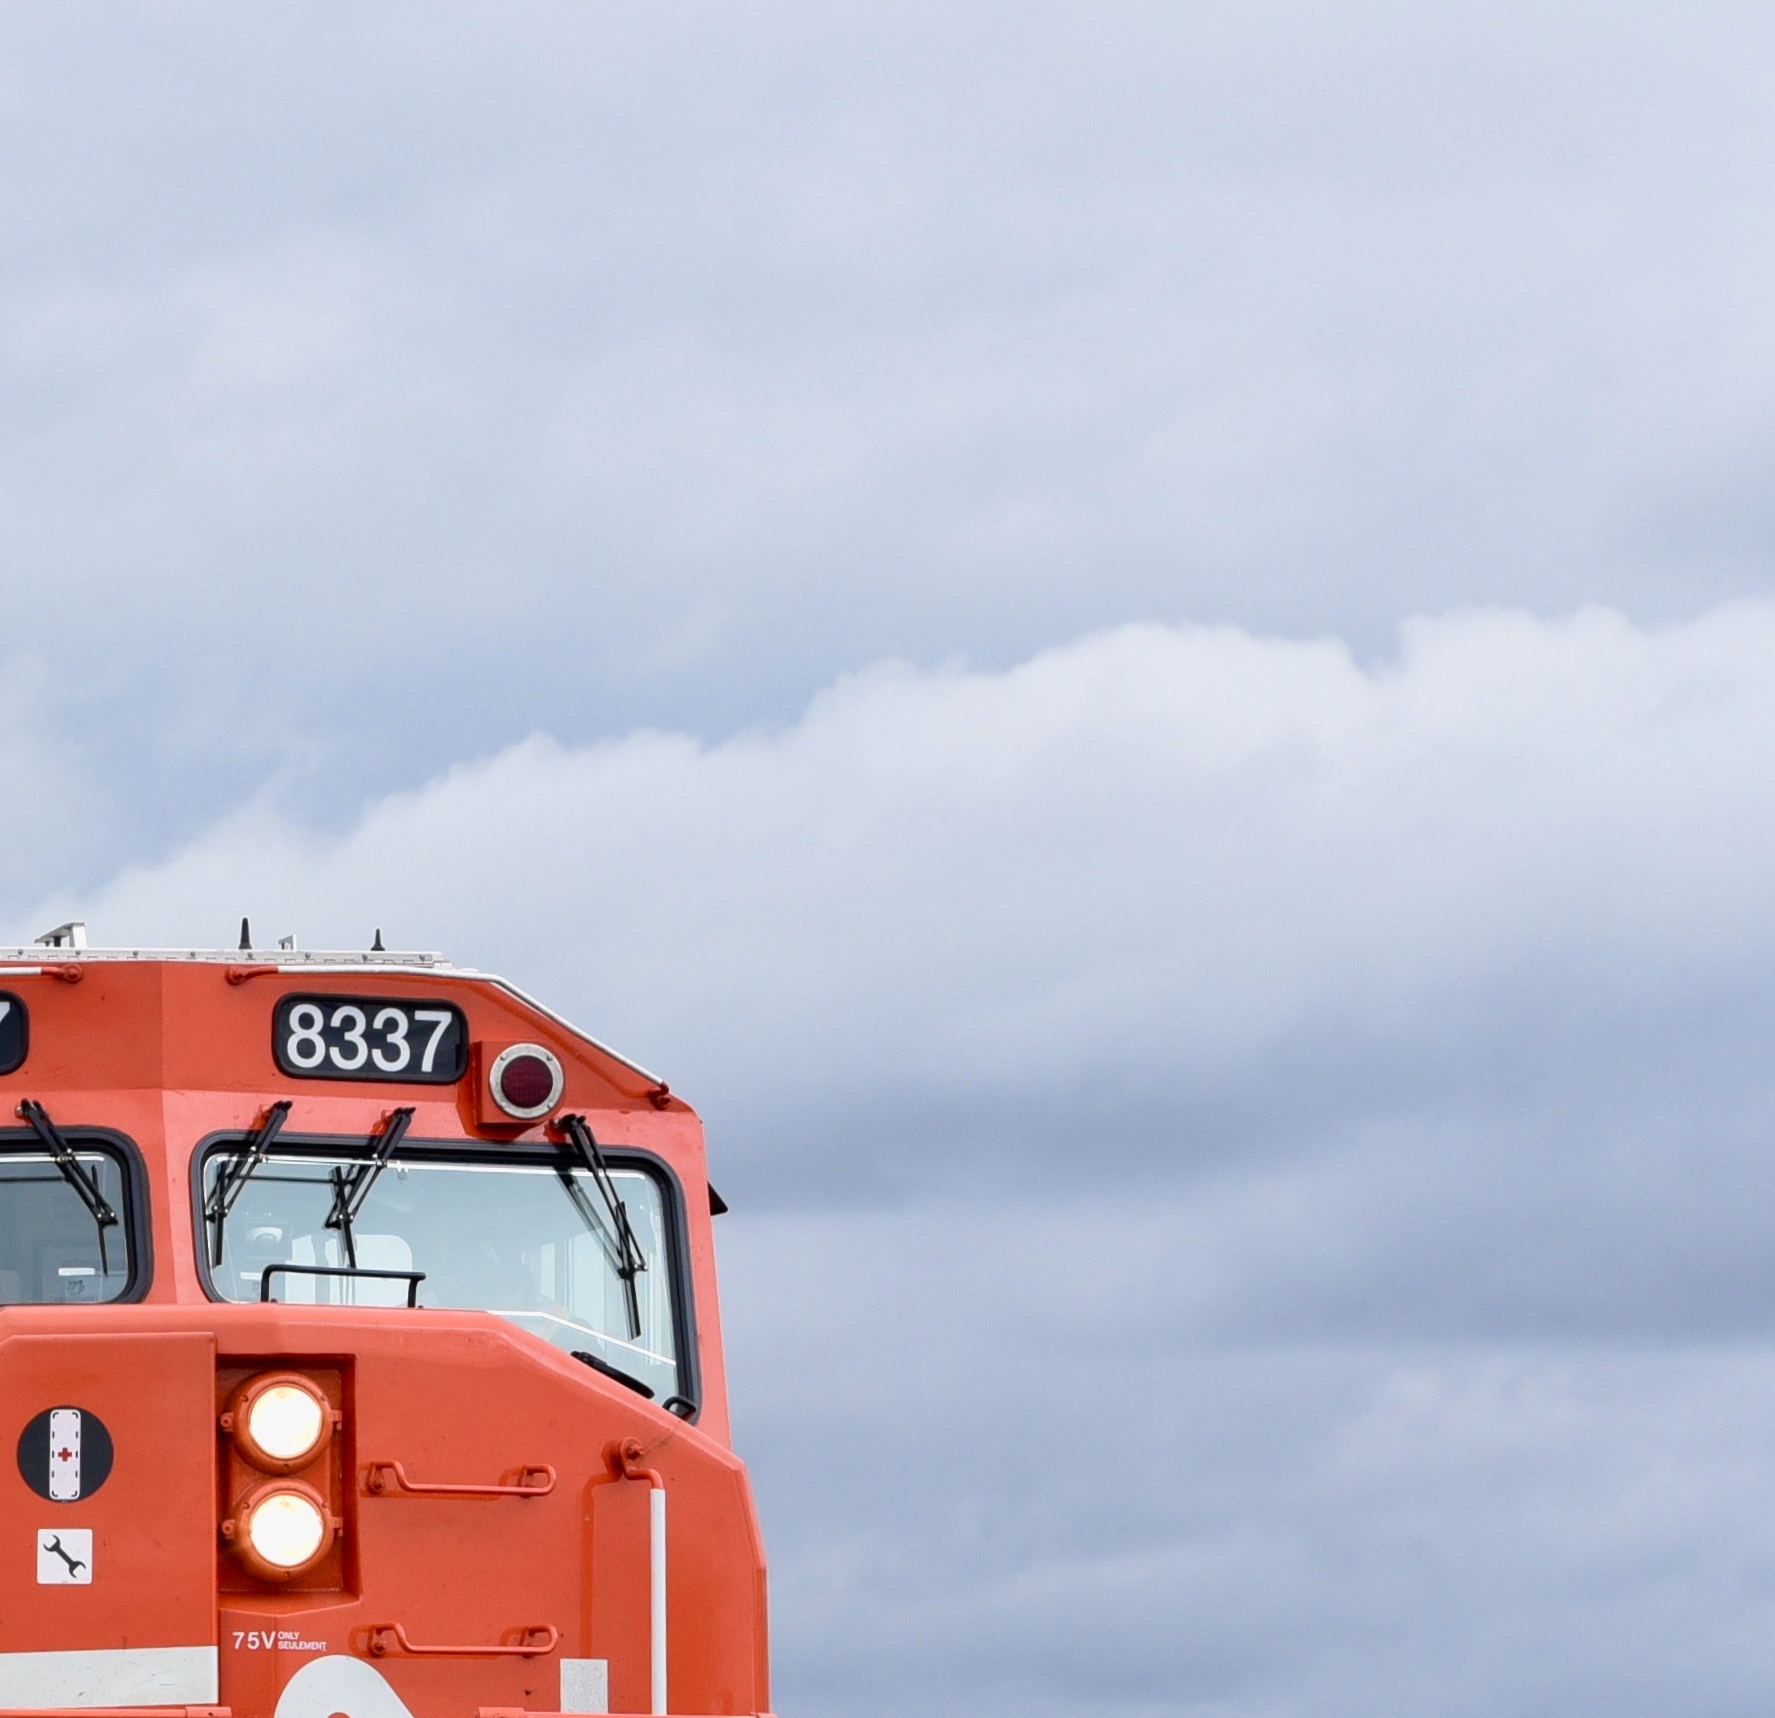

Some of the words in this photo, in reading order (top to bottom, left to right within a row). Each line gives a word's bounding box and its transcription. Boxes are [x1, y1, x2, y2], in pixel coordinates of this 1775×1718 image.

[286, 998, 453, 1075] 8337
[232, 1630, 276, 1650] 75V
[277, 1630, 301, 1640] ONLY
[277, 1641, 327, 1652] SEULEMENT
